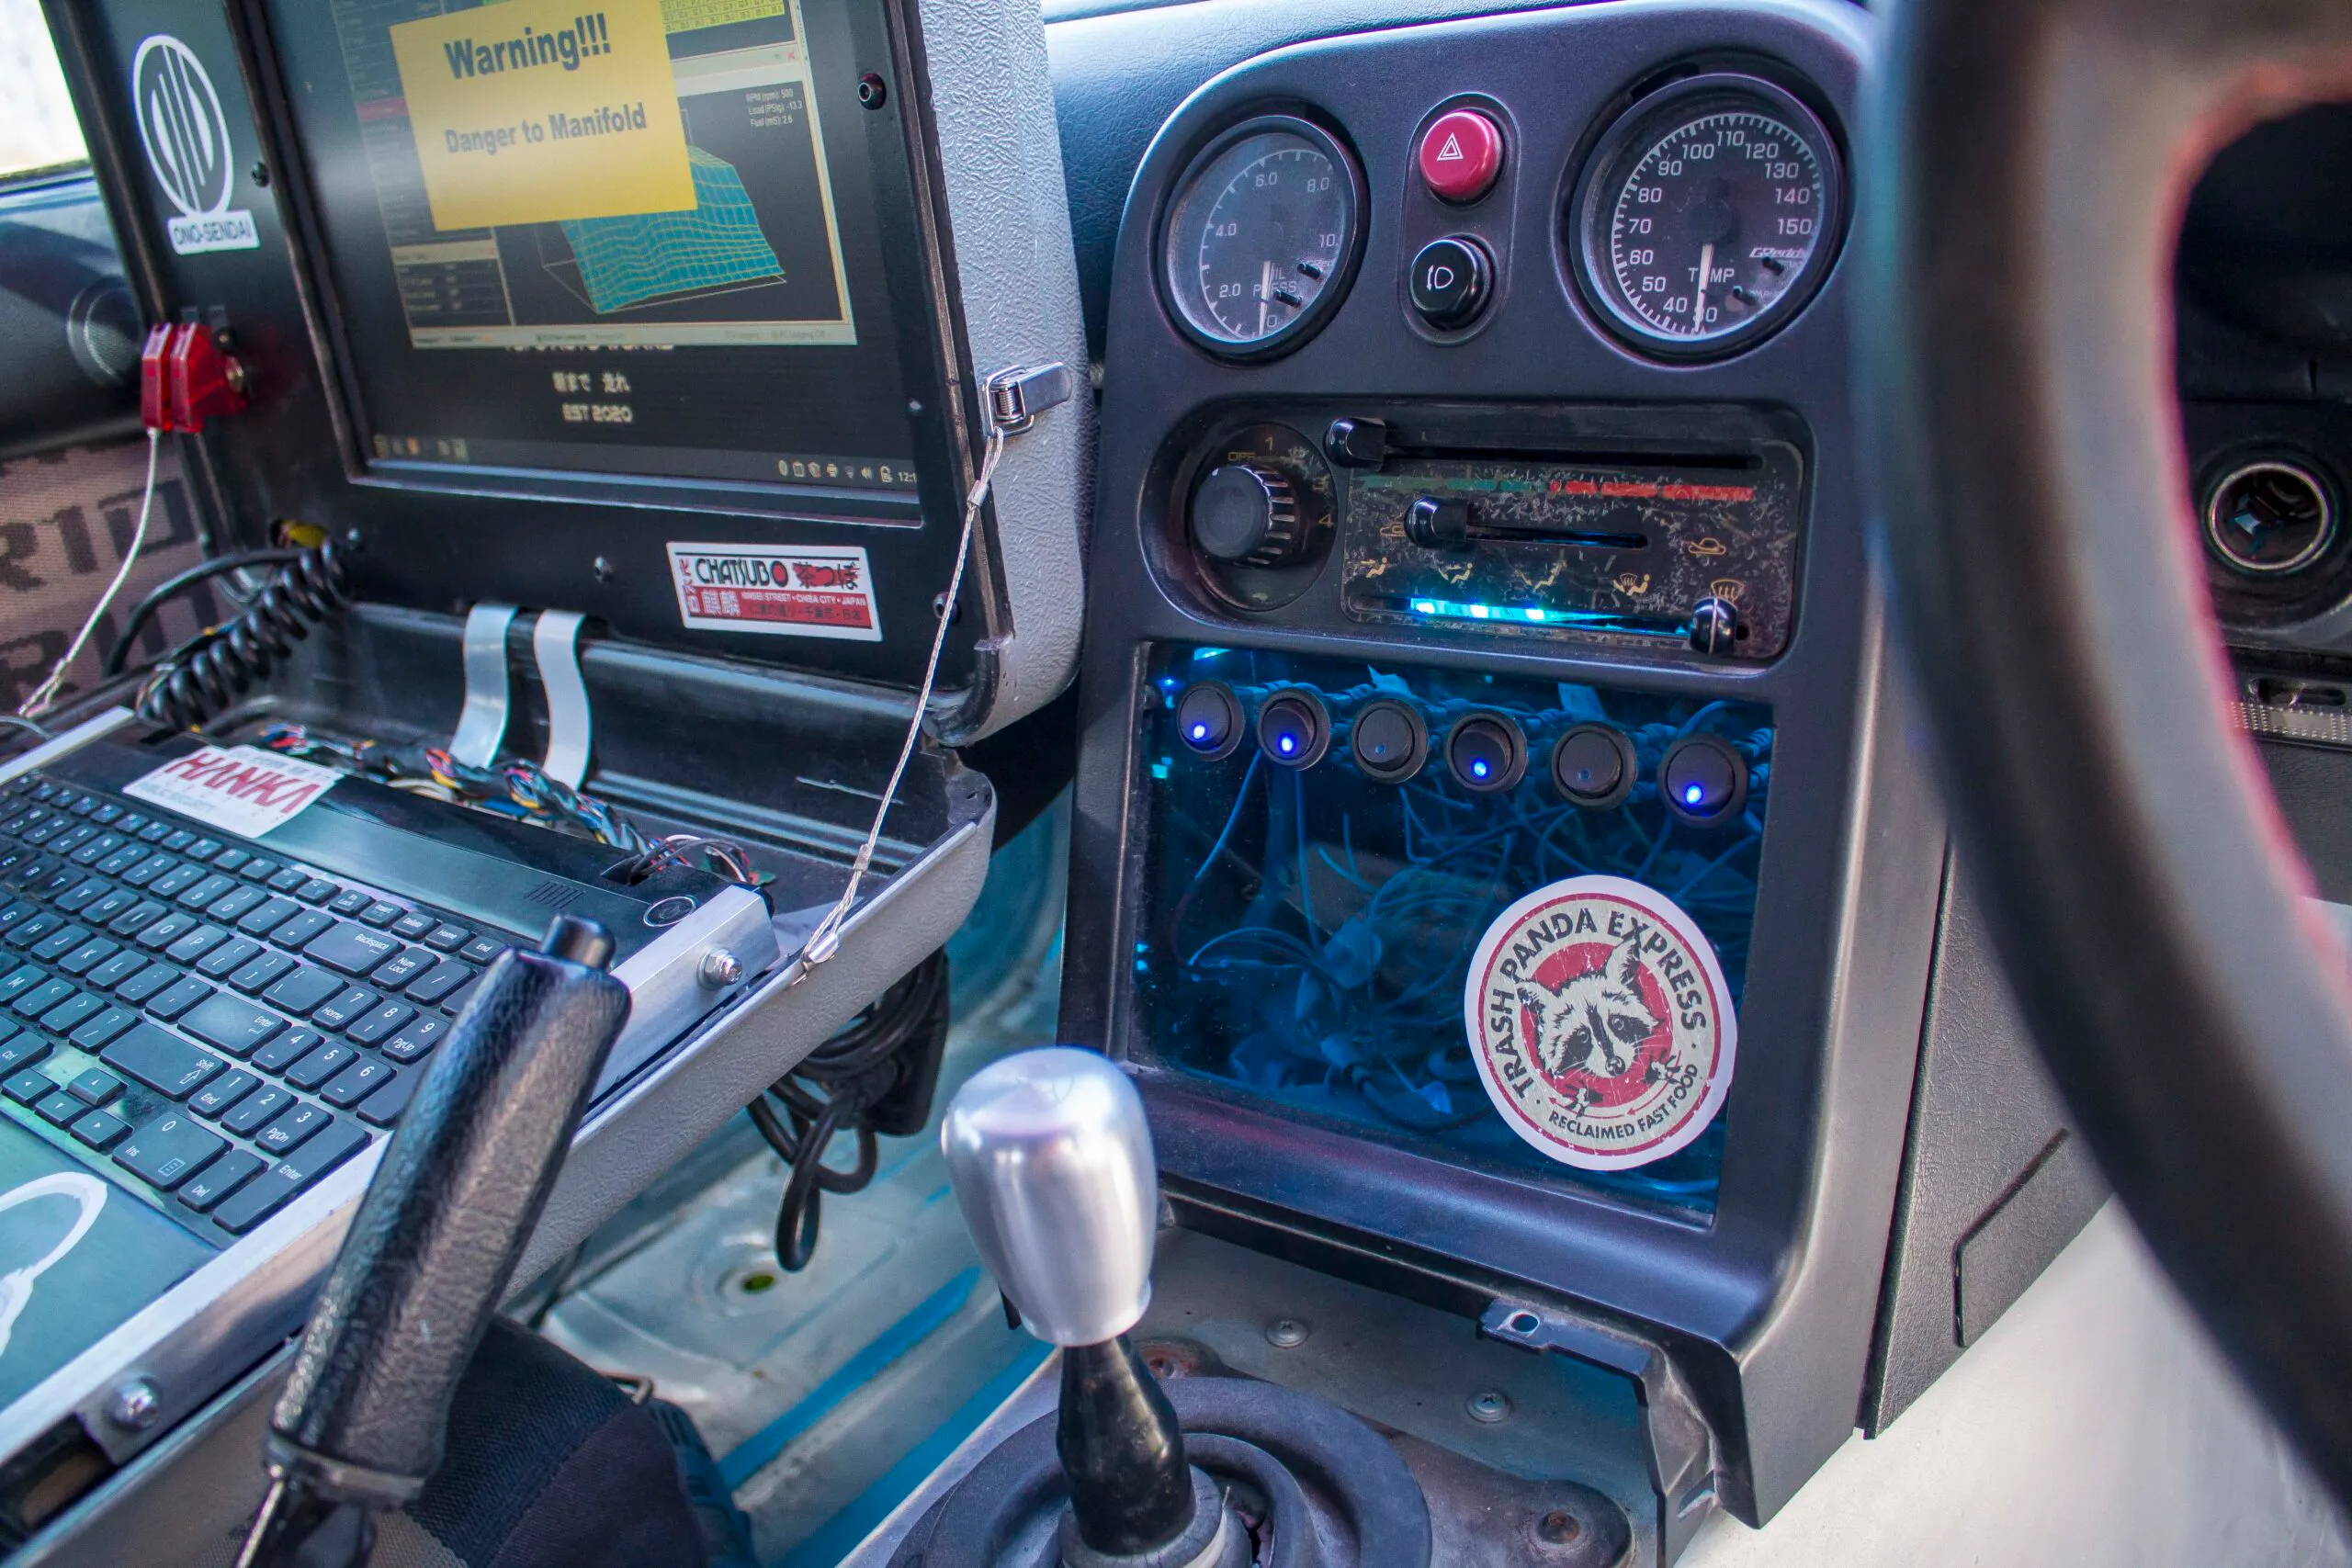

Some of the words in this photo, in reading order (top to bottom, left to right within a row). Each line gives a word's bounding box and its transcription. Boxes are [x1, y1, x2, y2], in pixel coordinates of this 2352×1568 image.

[443, 13, 611, 80] Warning!!!
[445, 126, 517, 155] Danger
[522, 118, 544, 143] to
[548, 102, 647, 141] Manifold
[1715, 130, 1745, 147] 110
[1681, 143, 1715, 160] 100
[1746, 142, 1780, 159] 120
[1657, 160, 1682, 176] 90
[1765, 163, 1799, 179] 130
[1255, 172, 1278, 187] 6.0
[1306, 176, 1329, 193] 8.0
[1637, 187, 1662, 203] 80
[1776, 187, 1810, 205] 140
[173, 220, 254, 245] ONO-SENDAI
[1216, 223, 1237, 237] 4.0
[1629, 219, 1652, 234] 70
[1778, 218, 1813, 235] 150
[1629, 249, 1654, 265] 60
[1688, 267, 1735, 284] TMP
[1219, 283, 1240, 298] 2.0
[1252, 281, 1297, 297] PESS
[1642, 276, 1667, 292] 50
[1663, 297, 1688, 313] 40
[1267, 314, 1278, 329] 0
[561, 403, 589, 422] EST
[591, 404, 633, 423] 2020
[1265, 436, 1273, 451] 1
[1227, 451, 1256, 461] OFF
[1318, 513, 1332, 527] 4
[695, 557, 789, 589] CHATSUBO
[51, 876, 66, 887] T
[77, 888, 92, 898] Y
[191, 891, 205, 901] 9
[104, 900, 119, 910] U
[221, 903, 234, 912] 0
[3, 910, 17, 921] G
[27, 923, 43, 934] H
[160, 924, 175, 934] O
[437, 929, 458, 941] Home
[54, 937, 70, 946] J
[189, 937, 205, 946] P
[355, 932, 390, 952] Backspace
[476, 942, 493, 953] End
[1499, 908, 1598, 983] PANDA
[81, 949, 96, 959] K
[110, 962, 123, 973] L
[388, 963, 408, 975] Lock
[397, 955, 416, 969] Num
[1607, 909, 1707, 1031] EXPRESS
[7, 976, 26, 988] M
[349, 992, 364, 1004] 7
[322, 1007, 345, 1021] Home
[384, 1007, 399, 1018] 8
[254, 1015, 275, 1028] Enter
[420, 1022, 435, 1033] 9
[289, 1034, 305, 1044] 4
[393, 1037, 415, 1051] PgUp
[1490, 988, 1534, 1100] TRASH
[324, 1049, 340, 1060] 5
[196, 1058, 214, 1072] Shift
[359, 1066, 375, 1077] 6
[228, 1076, 243, 1088] 1
[200, 1092, 220, 1106] End
[260, 1093, 276, 1105] 2
[1548, 1110, 1635, 1140] RECLAIMED
[1637, 1104, 1670, 1133] FAST
[1666, 1064, 1698, 1110] FOOD
[296, 1111, 312, 1123] 3
[162, 1120, 177, 1132] 0
[266, 1126, 289, 1143] PgDn
[125, 1145, 141, 1157] Ins
[278, 1164, 302, 1180] Enter
[191, 1184, 211, 1198] Del
